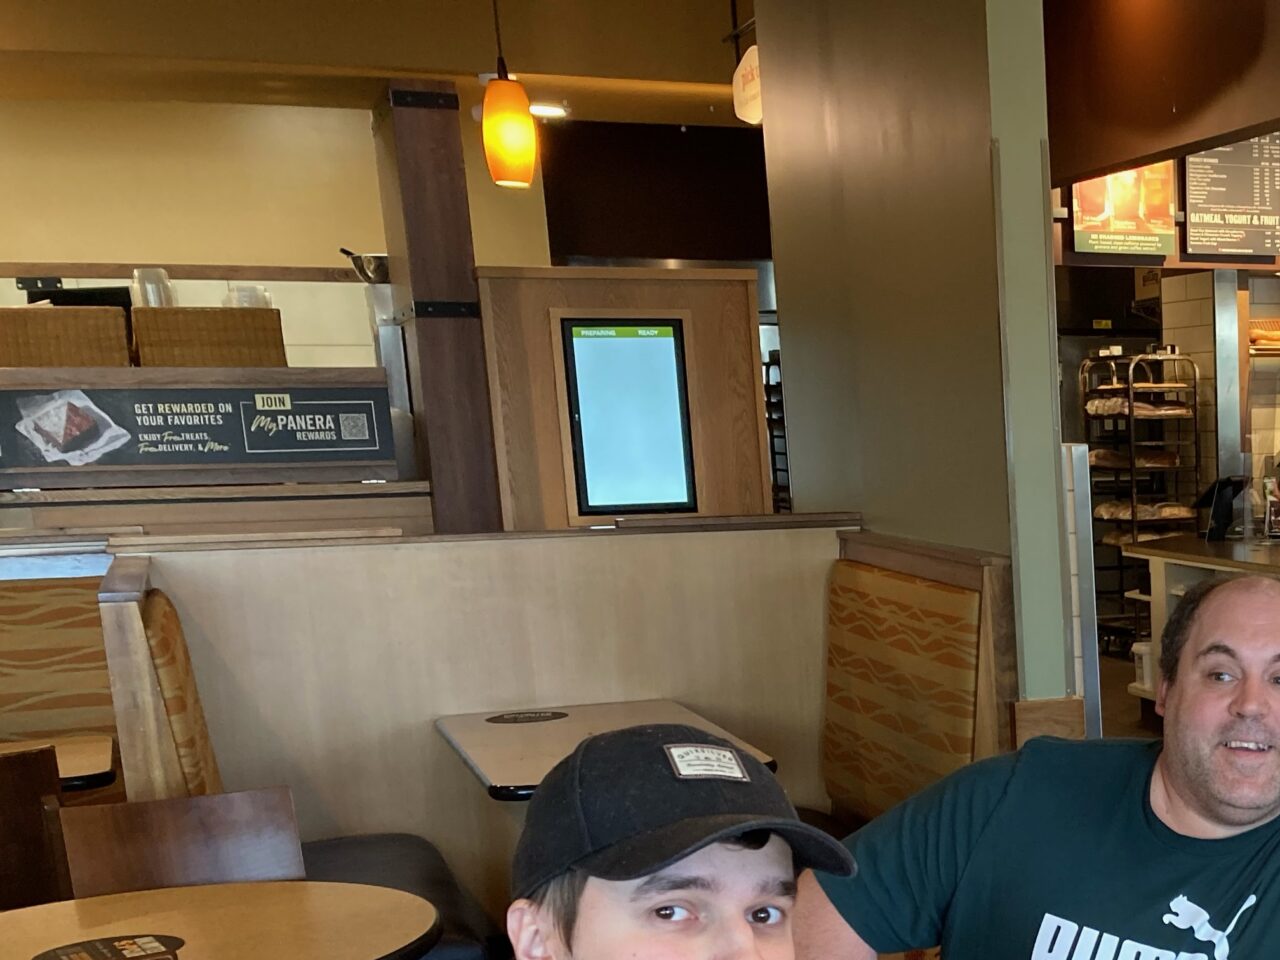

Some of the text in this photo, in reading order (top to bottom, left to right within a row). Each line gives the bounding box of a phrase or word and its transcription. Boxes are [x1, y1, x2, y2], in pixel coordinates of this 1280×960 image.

[1225, 214, 1251, 225] YOGURT
[1260, 215, 1280, 226] FRUIT
[262, 396, 286, 408] JOIN
[134, 403, 232, 414] GET REWARDED ON
[136, 414, 223, 426] YOUR FAVORITES
[138, 433, 160, 441] ENJOY
[296, 431, 336, 441] REWARDS
